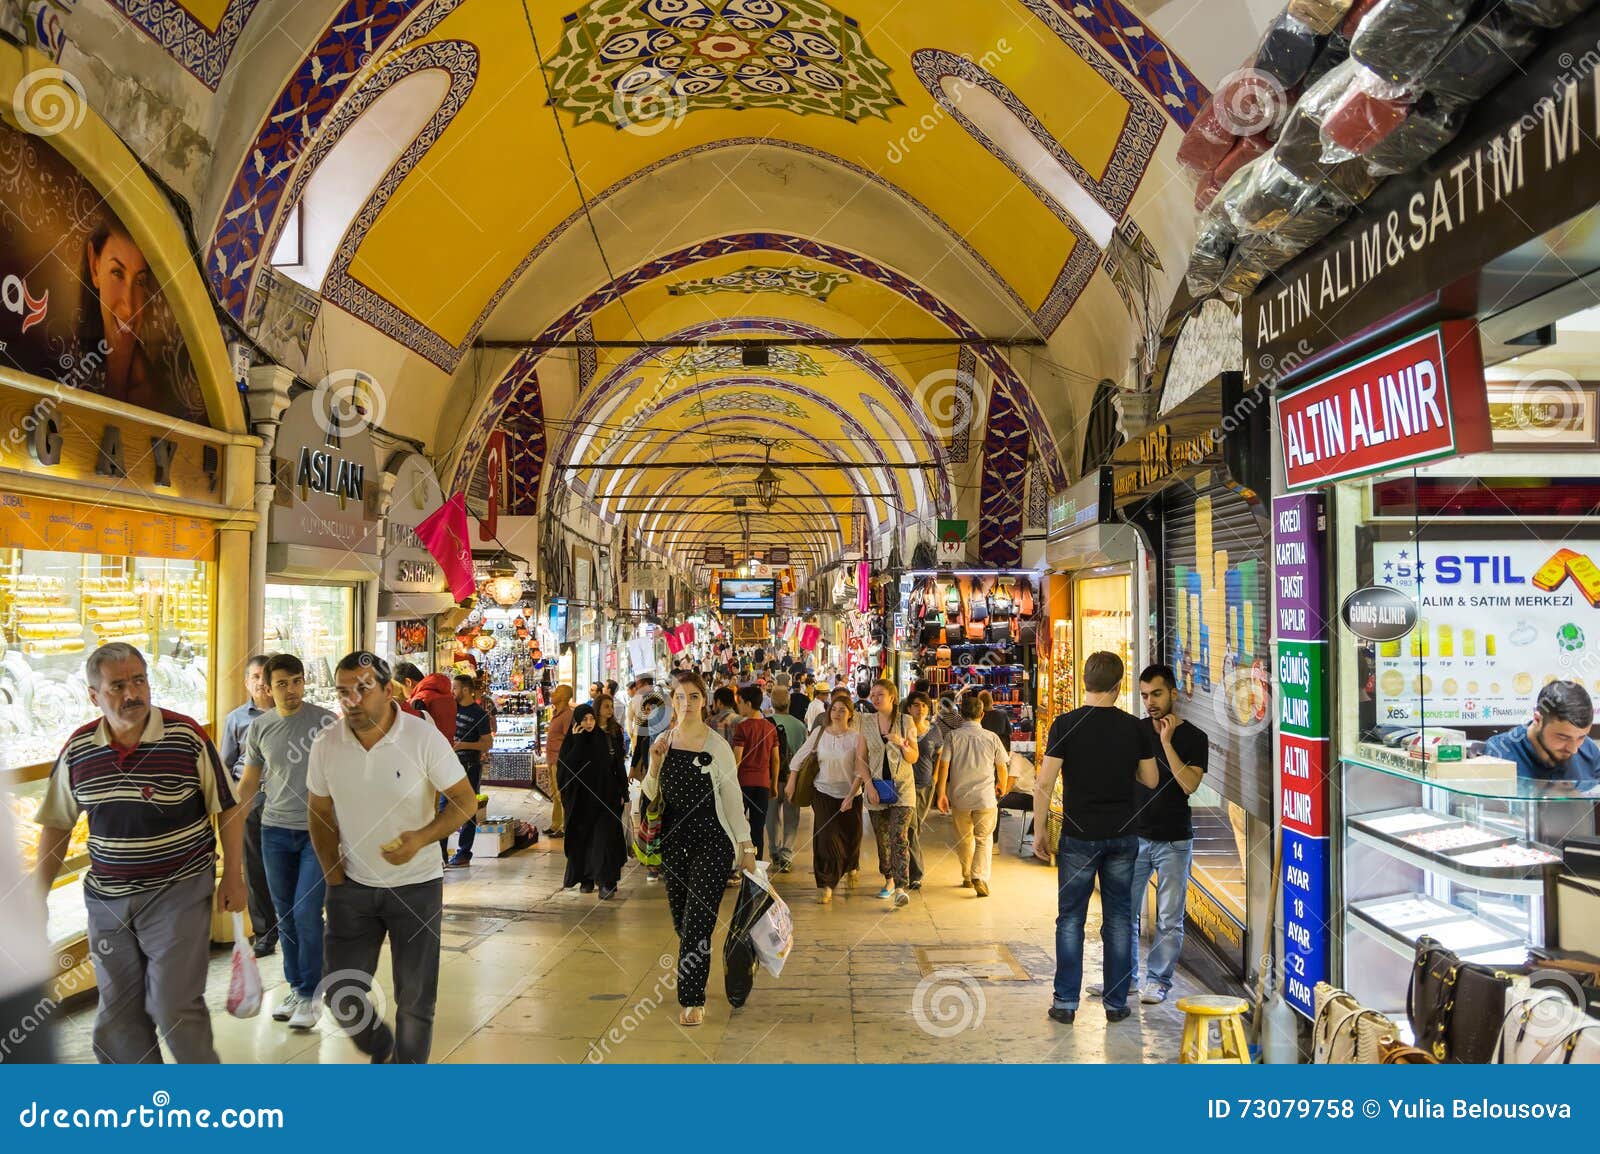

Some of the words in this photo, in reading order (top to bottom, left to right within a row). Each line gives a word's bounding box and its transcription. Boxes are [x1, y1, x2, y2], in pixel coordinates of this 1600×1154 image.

[1257, 273, 1311, 349] ALTIN
[1242, 358, 1251, 385] 4
[1287, 394, 1345, 469] ALTIN
[1350, 359, 1444, 452] ALINIR
[1140, 424, 1169, 487] NDR
[296, 446, 364, 501] ASLAN
[1279, 504, 1301, 534] KREDİ
[1276, 541, 1306, 566] KARTINA
[1435, 555, 1526, 584] STIL
[1279, 571, 1304, 600] TAKSİT
[1422, 597, 1453, 608] ALIM
[1458, 597, 1467, 607] &
[1471, 596, 1511, 607] SATIM
[1515, 593, 1574, 607] MERKEZİ
[1280, 608, 1307, 633] YAPILIR
[1349, 606, 1378, 629] GÜMÜŞ
[1379, 607, 1407, 626] ALINIR
[1279, 651, 1310, 693] GÜMÜŞ
[1282, 696, 1310, 729] ALINIR
[1284, 744, 1309, 779] ALTIN
[1283, 788, 1312, 826] ALINIR
[1292, 840, 1303, 861] 14
[1287, 865, 1310, 891] AYAR
[1293, 898, 1304, 919] 18
[1288, 921, 1310, 949] AYAR
[1294, 954, 1305, 976] 22
[1289, 977, 1311, 1007] AYAR
